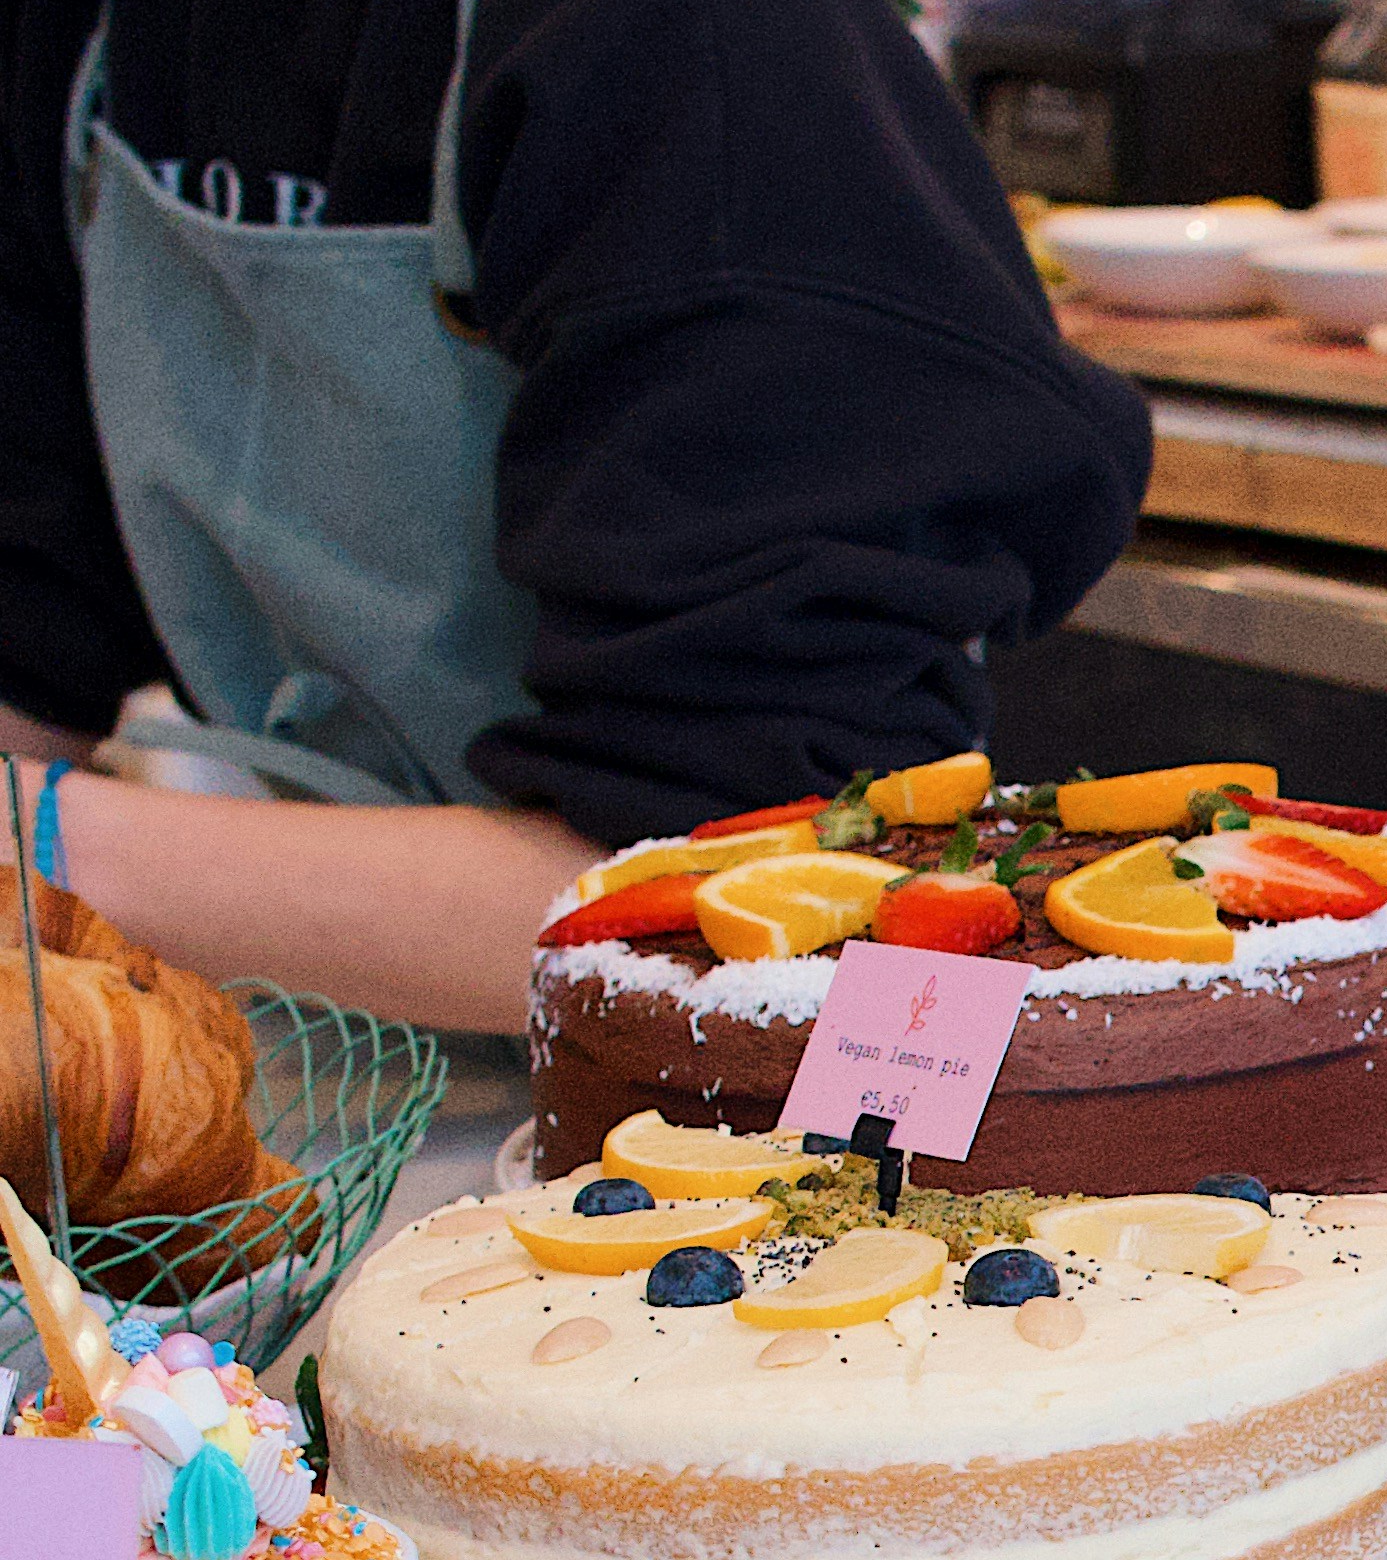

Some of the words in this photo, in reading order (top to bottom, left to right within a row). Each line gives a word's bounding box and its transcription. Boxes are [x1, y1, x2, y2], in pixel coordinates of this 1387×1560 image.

[837, 1037, 880, 1061] Vegan
[888, 1046, 934, 1070] lemon
[940, 1058, 971, 1077] pie
[860, 1090, 911, 1115] €5,50
